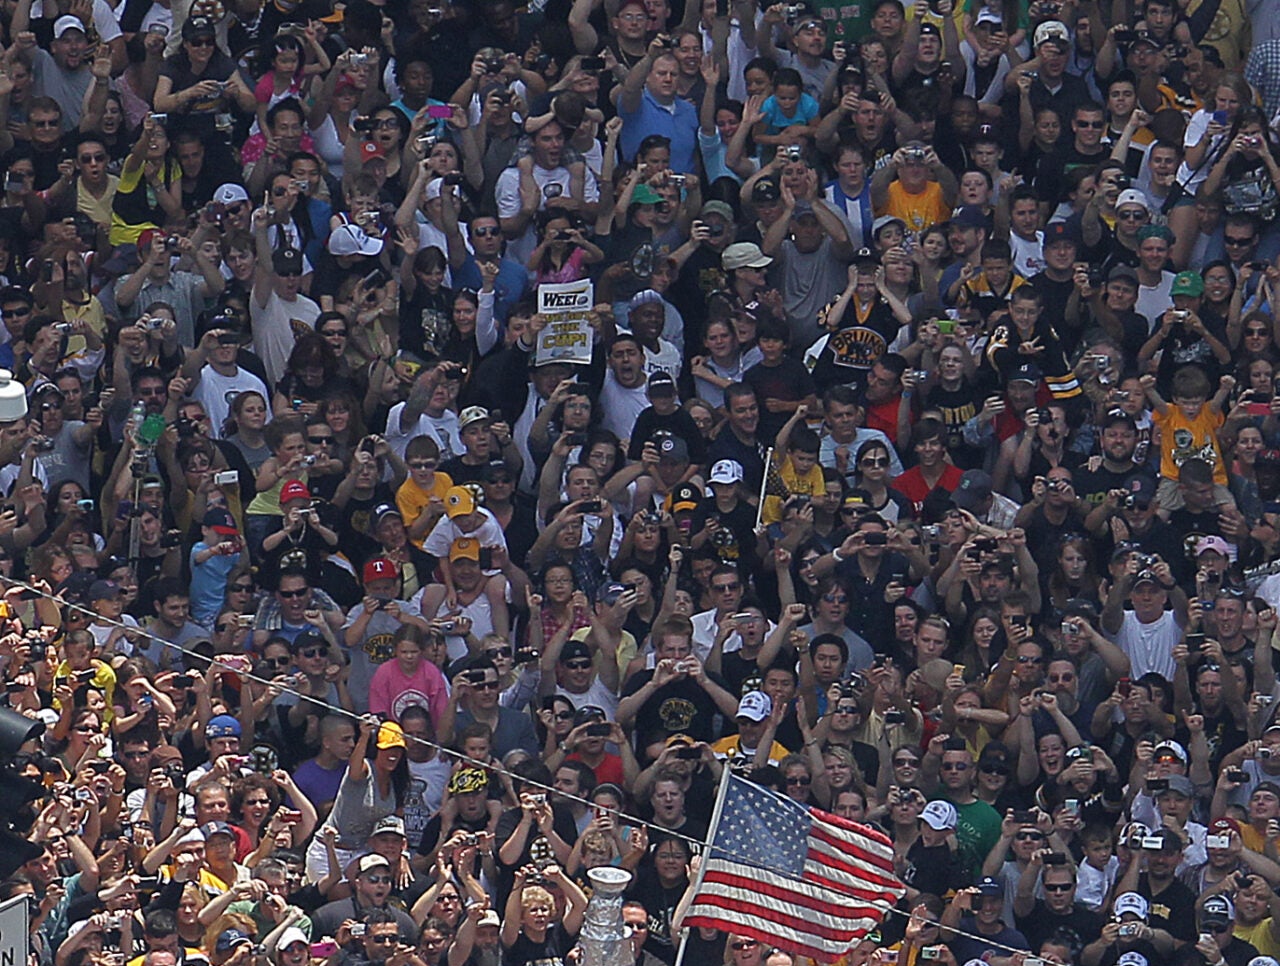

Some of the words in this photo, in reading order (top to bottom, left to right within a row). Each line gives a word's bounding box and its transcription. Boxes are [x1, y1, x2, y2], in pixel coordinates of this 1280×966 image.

[543, 293, 577, 307] WEEI
[543, 334, 586, 349] CUP!
[831, 329, 885, 356] BRUINS
[373, 561, 384, 572] T
